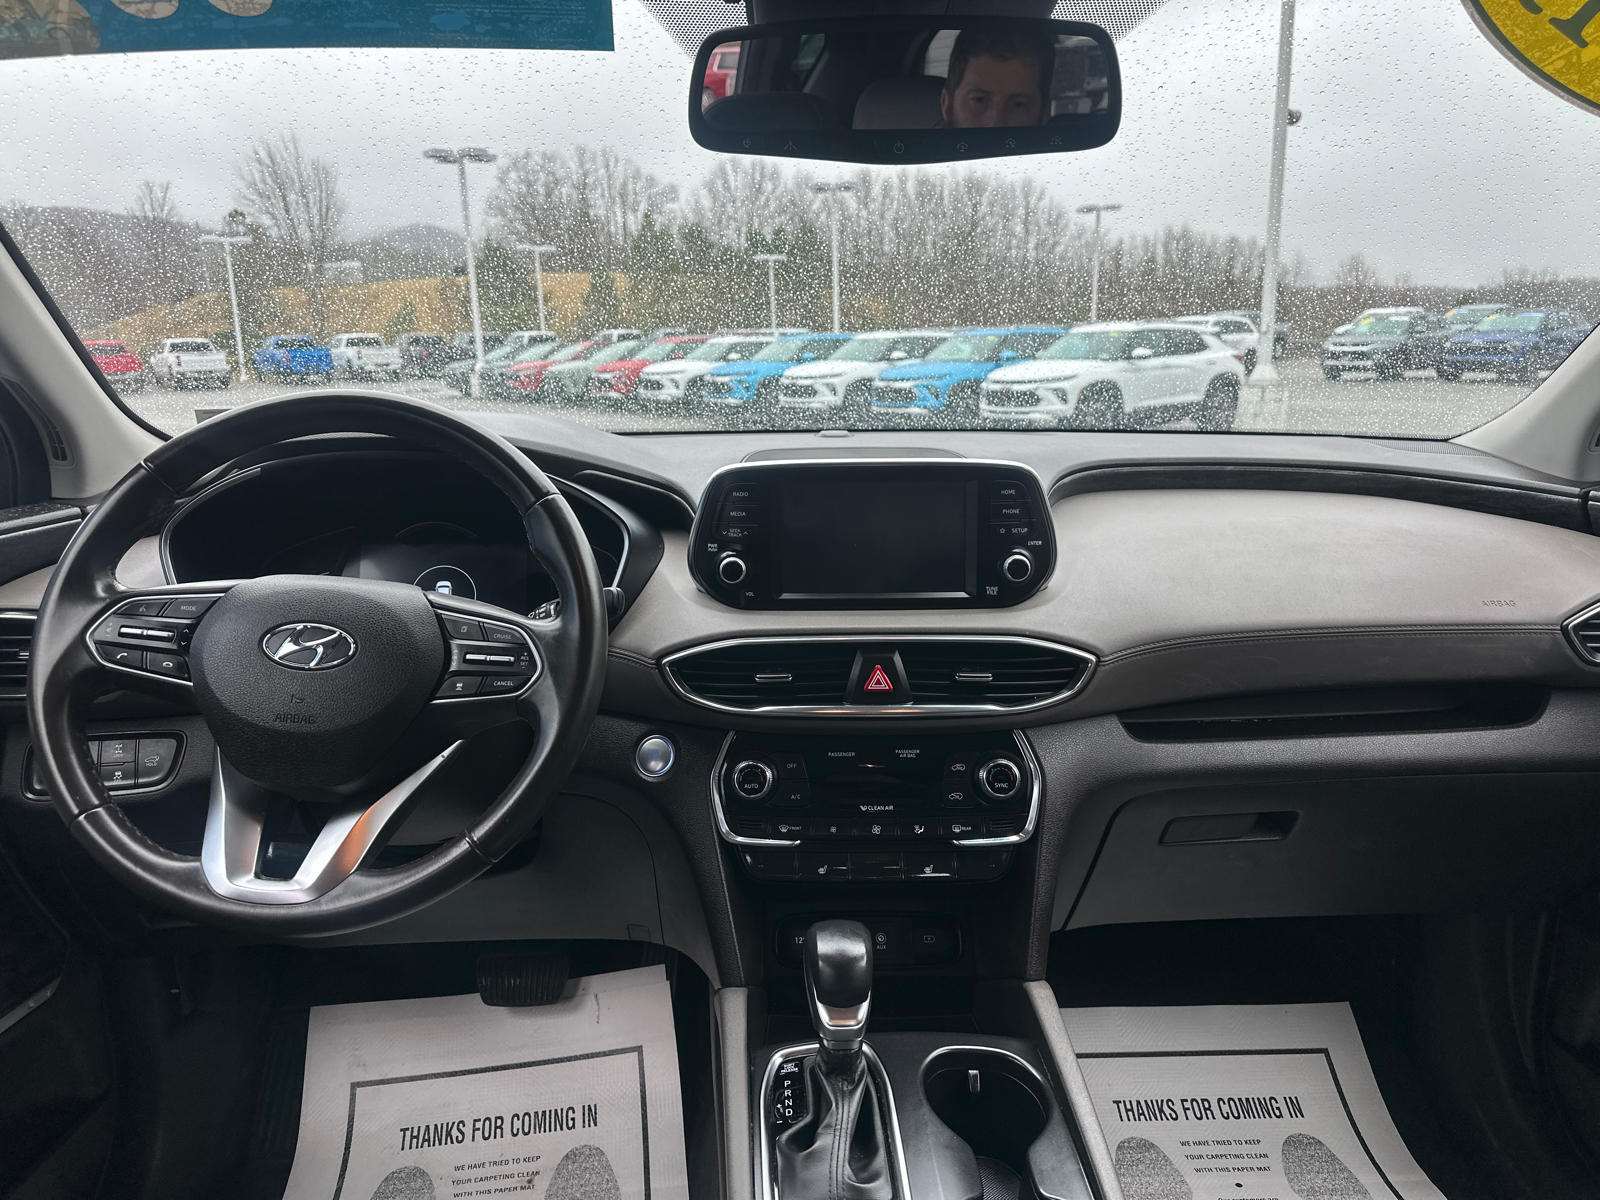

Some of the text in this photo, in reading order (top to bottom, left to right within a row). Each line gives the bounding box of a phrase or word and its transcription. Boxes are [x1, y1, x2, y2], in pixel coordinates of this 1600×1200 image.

[274, 713, 315, 724] AIRBAG
[784, 1080, 792, 1088] P
[1112, 1096, 1305, 1122] THANKS FOR COMING IN
[400, 1103, 598, 1151] THANKS FOR COMING IN
[454, 1164, 466, 1172] WE
[467, 1162, 486, 1170] HAVE
[488, 1160, 510, 1168] TRIED
[522, 1155, 541, 1163] KEEP
[451, 1170, 540, 1186] YOUR CARPETING CLEAN
[494, 1186, 518, 1194] PAPER
